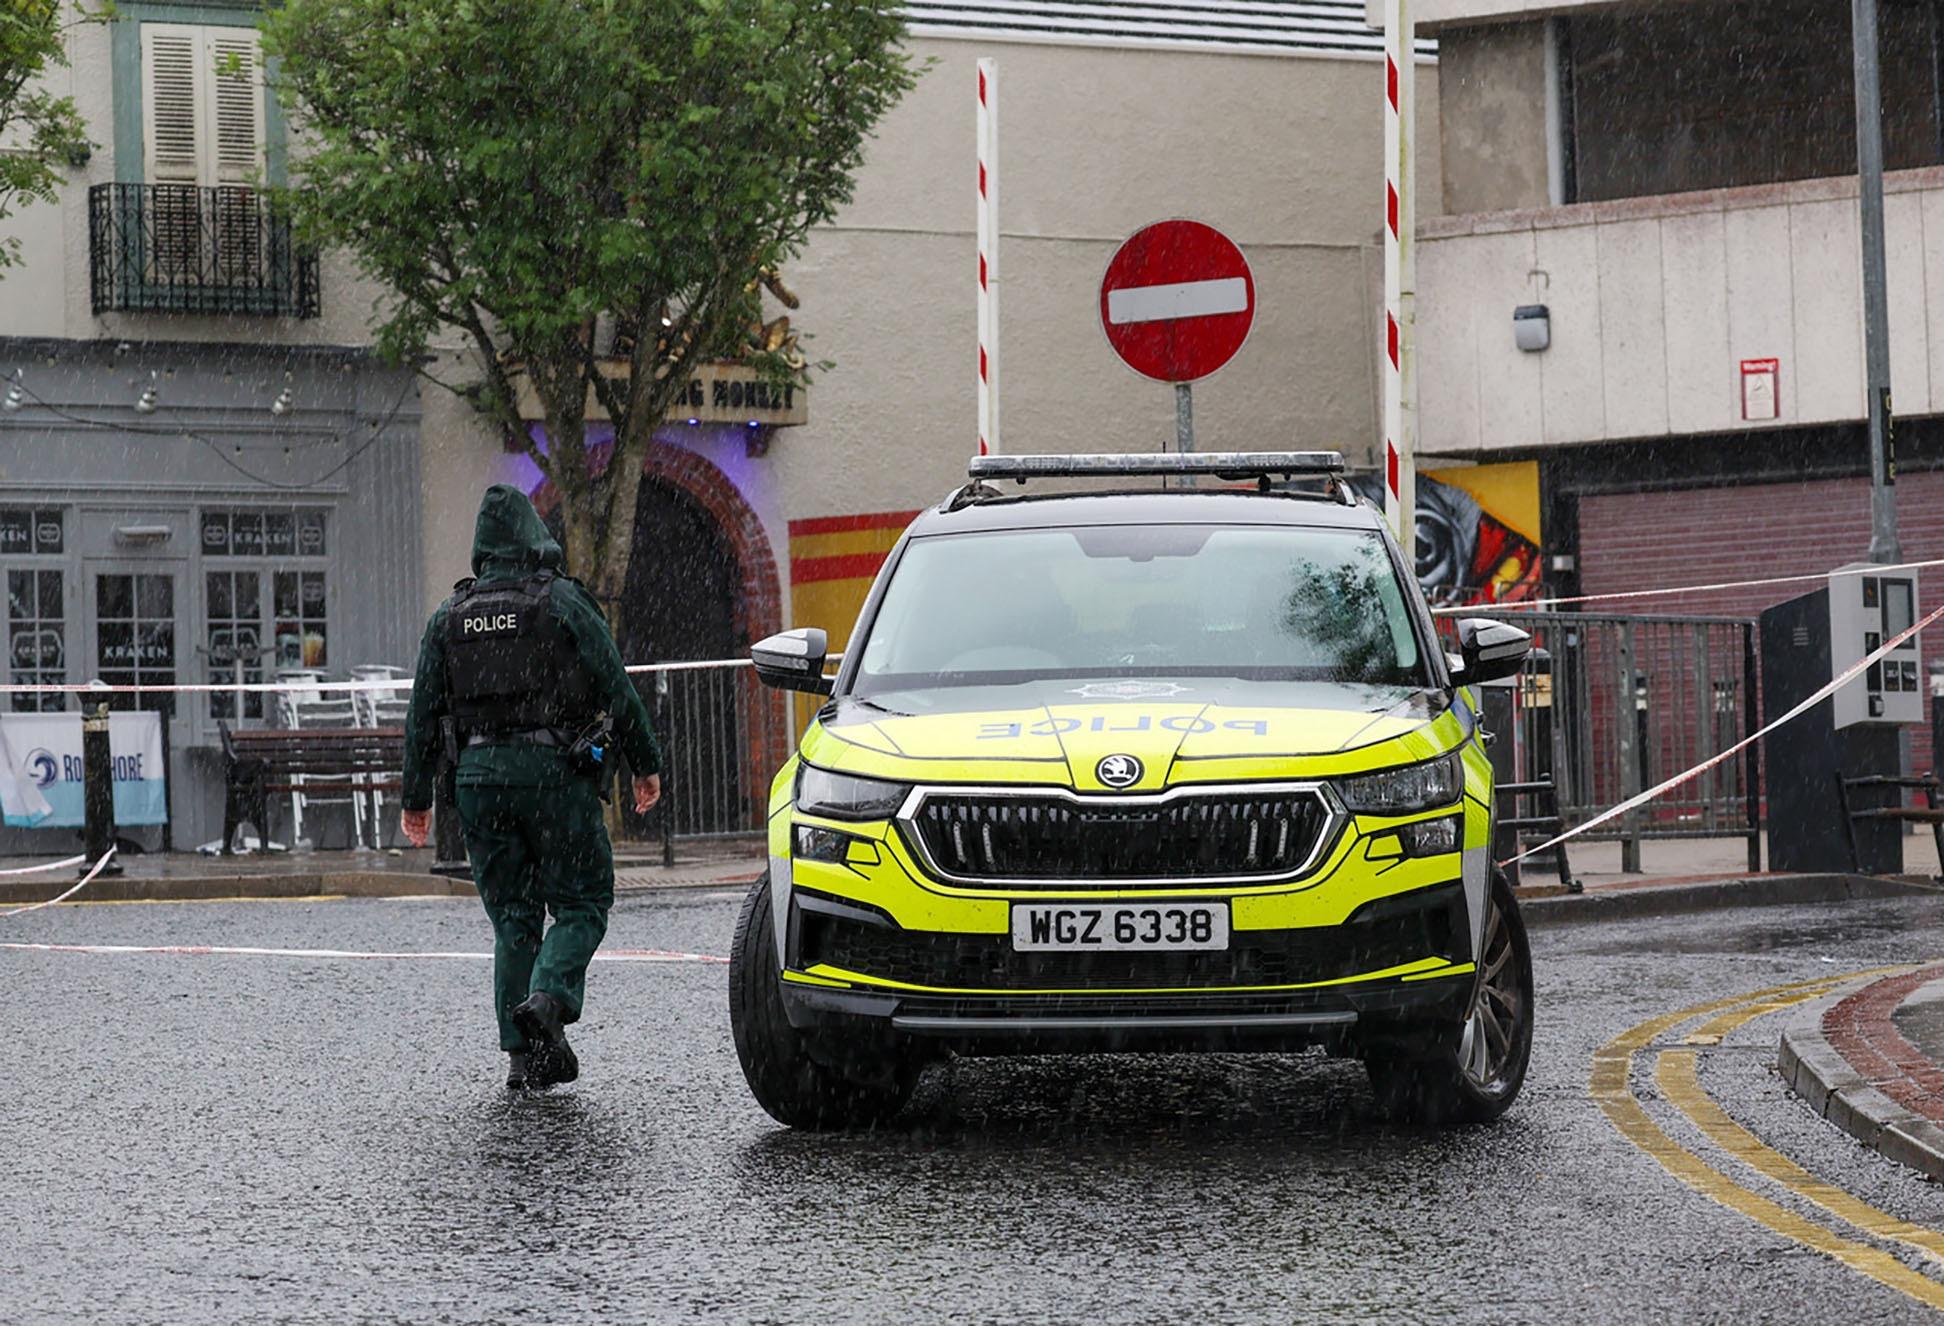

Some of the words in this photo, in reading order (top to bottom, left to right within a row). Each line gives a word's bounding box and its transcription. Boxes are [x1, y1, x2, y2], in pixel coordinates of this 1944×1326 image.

[464, 613, 517, 635] POLICE
[104, 645, 168, 659] KRAKEN
[63, 753, 144, 783] ROHORE
[1030, 910, 1102, 944] WGZ
[1114, 909, 1212, 943] 6338
